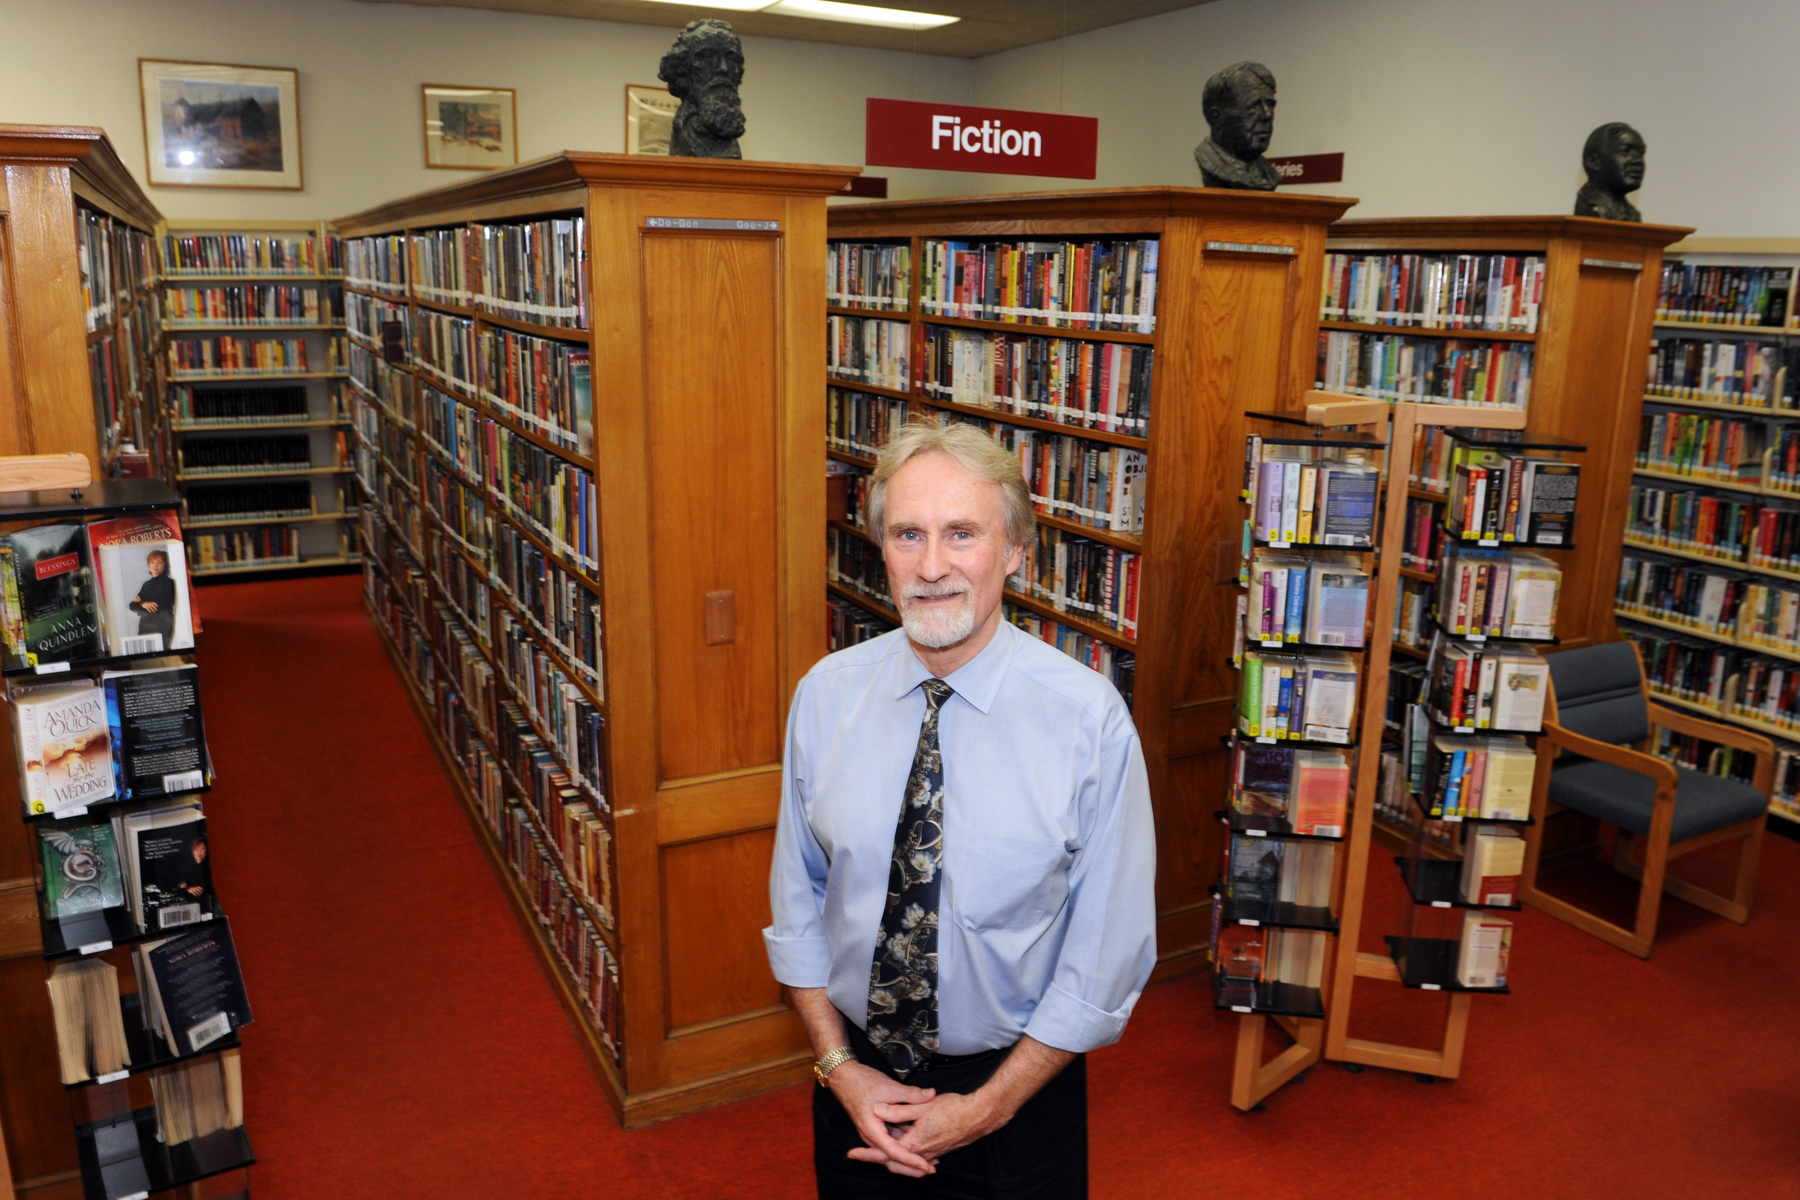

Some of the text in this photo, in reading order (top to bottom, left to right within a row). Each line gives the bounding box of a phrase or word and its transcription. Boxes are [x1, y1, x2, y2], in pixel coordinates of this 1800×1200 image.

[931, 114, 1042, 157] Fiction
[1272, 161, 1304, 177] eries
[658, 218, 769, 230] Do-Gon Goo-J
[994, 336, 1006, 367] Wolf
[1125, 453, 1141, 463] AN
[130, 527, 172, 545] ROBERTS
[39, 559, 77, 574] BLESSINGS
[1294, 574, 1303, 595] Barbara
[1291, 595, 1301, 617] Delinsky
[51, 617, 82, 635] ANNA
[39, 625, 97, 651] QUINDLEN
[43, 700, 102, 729] AMANDA
[49, 714, 100, 738] QUICK
[66, 757, 97, 779] LATE
[54, 775, 107, 803] WEDDING
[63, 771, 96, 788] for the
[35, 803, 45, 813] Q
